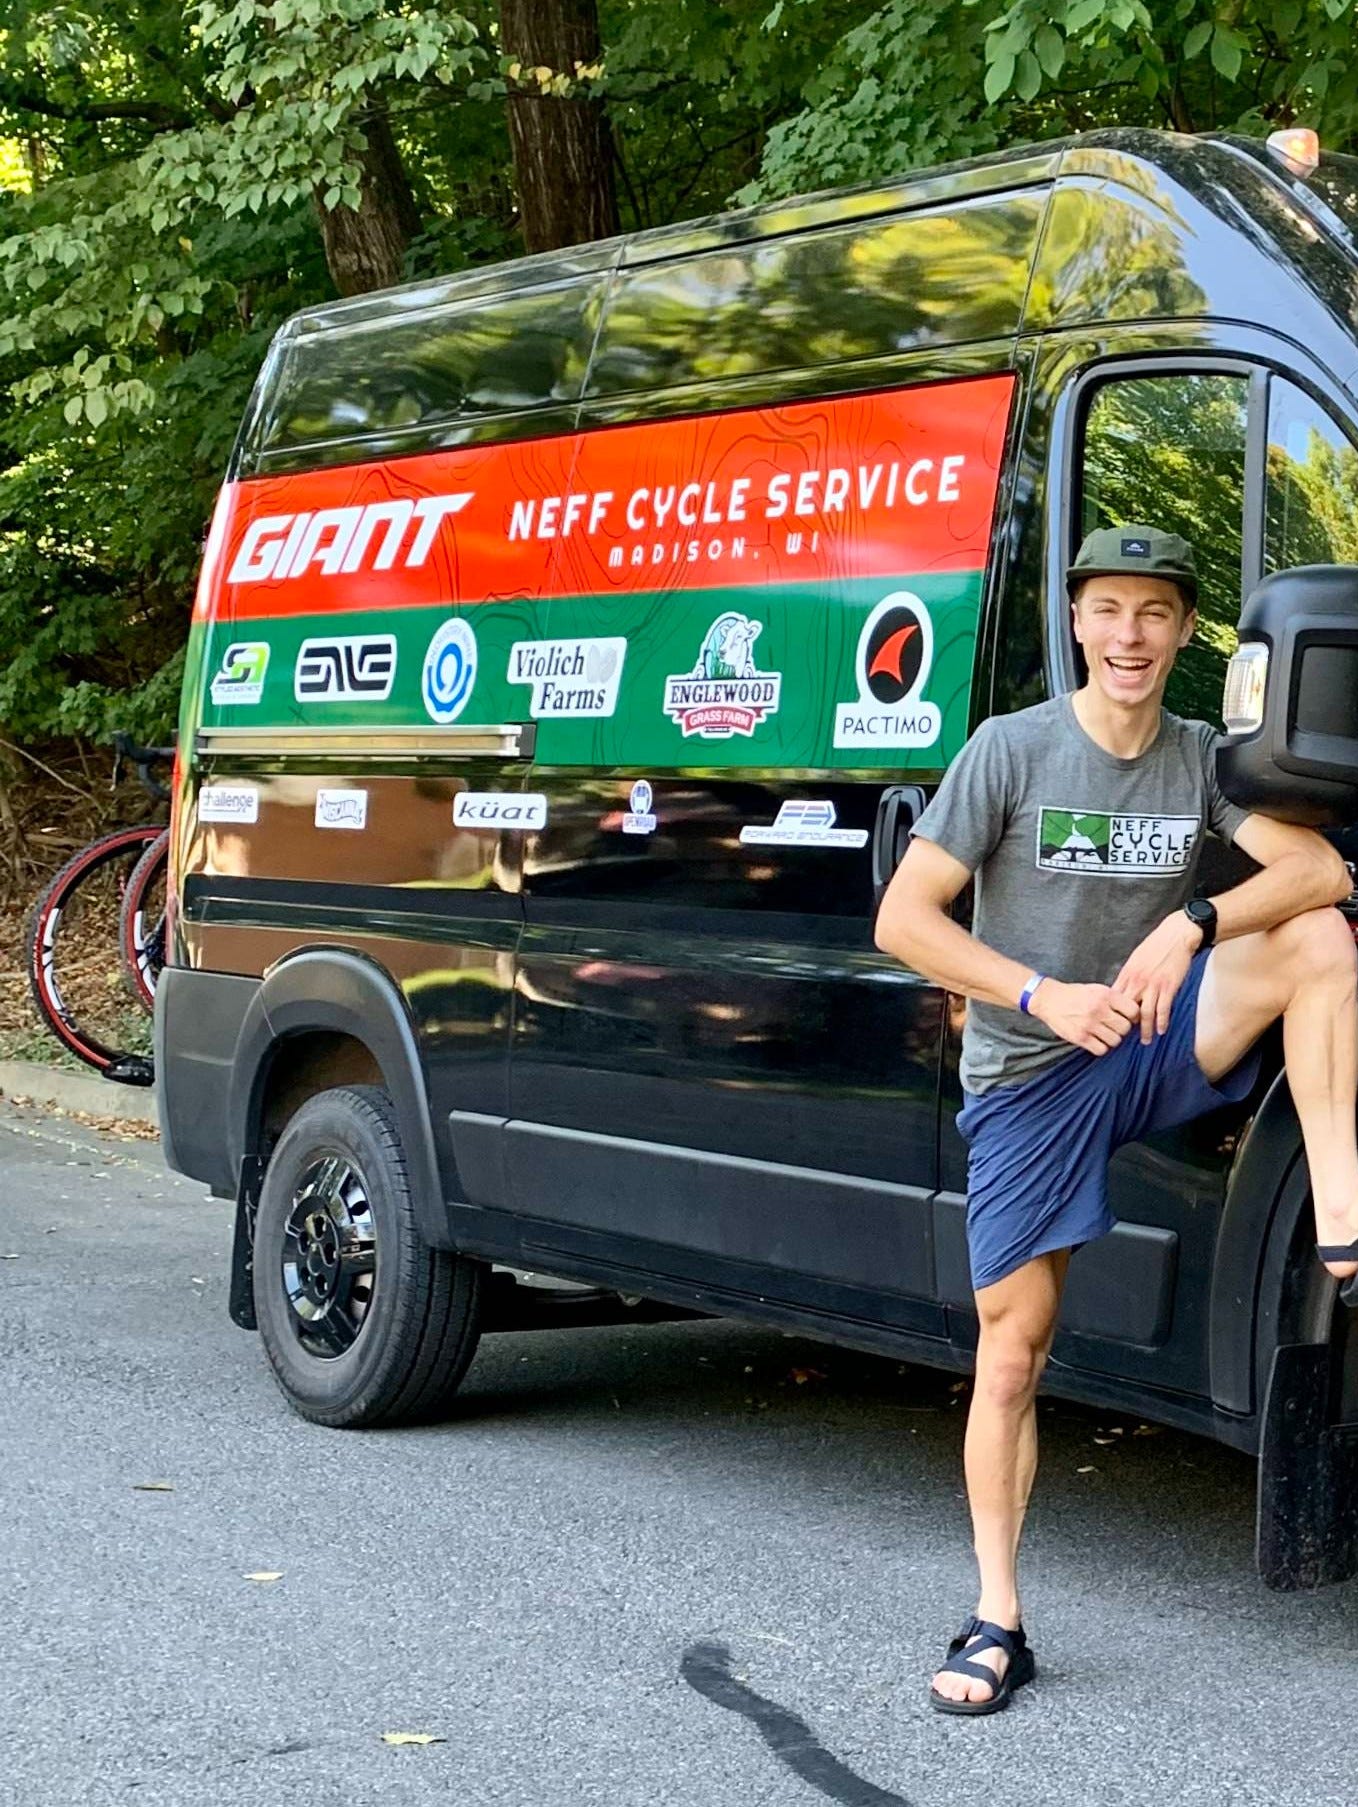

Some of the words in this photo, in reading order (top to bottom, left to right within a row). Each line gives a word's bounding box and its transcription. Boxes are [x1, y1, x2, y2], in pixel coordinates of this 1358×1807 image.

[508, 491, 614, 541] NEFF
[626, 478, 751, 531] CYCLE
[765, 455, 966, 518] SERVICE
[227, 492, 475, 583] GIANT
[786, 531, 819, 555] WI
[517, 645, 585, 677] Violich
[538, 682, 606, 710] Farms
[670, 683, 775, 703] ENGLEWOOD
[689, 709, 722, 726] GRASS
[723, 710, 751, 727] FARM
[843, 715, 933, 737] PACTIMO
[457, 799, 538, 820] küat
[1112, 819, 1162, 832] NEFF
[1111, 832, 1193, 851] CYCLE
